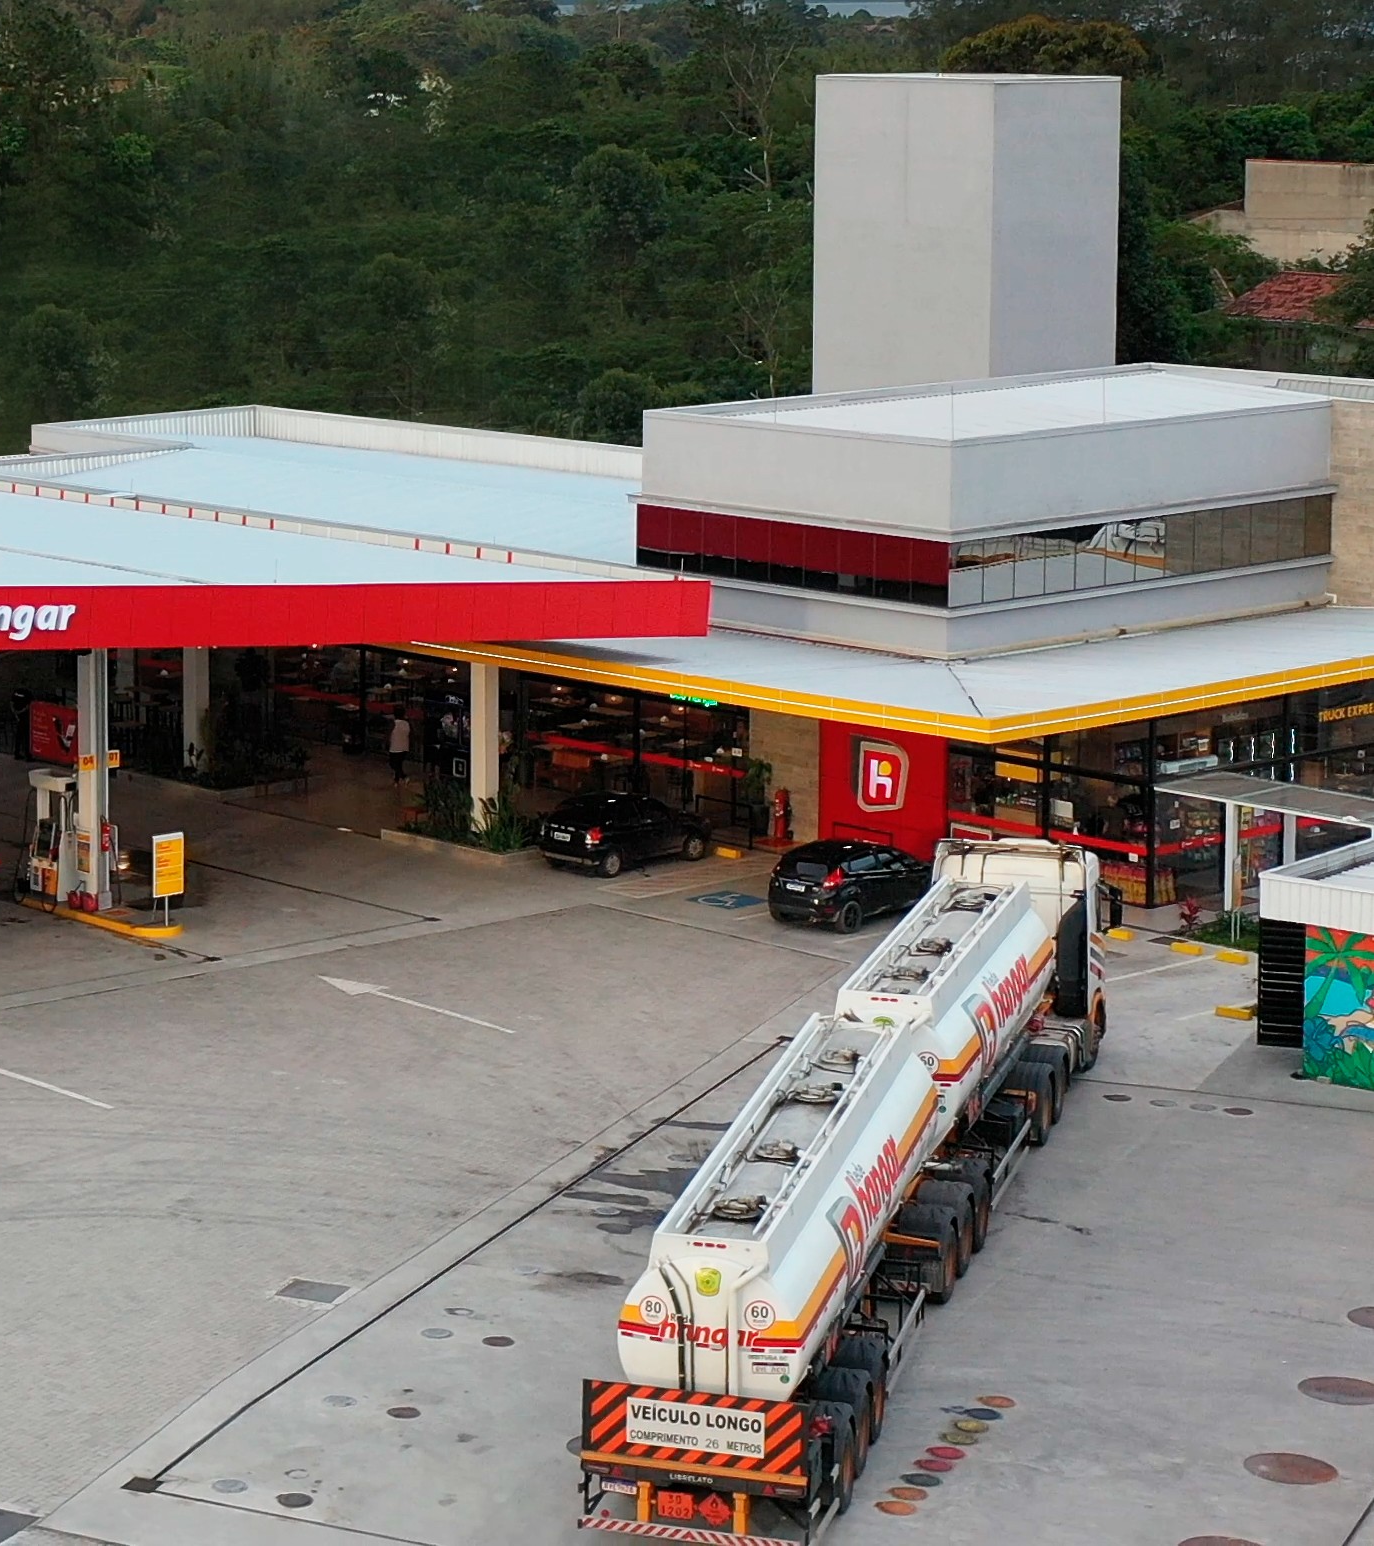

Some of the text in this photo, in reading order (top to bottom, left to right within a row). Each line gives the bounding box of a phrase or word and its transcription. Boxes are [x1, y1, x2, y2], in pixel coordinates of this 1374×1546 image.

[1319, 707, 1345, 722] TRUCK
[645, 1300, 662, 1314] 80
[750, 1305, 769, 1319] 60
[631, 1403, 762, 1433] VEÍCULO LONGO
[630, 1429, 762, 1454] COMPRIMENTO 26 METROS
[668, 1494, 682, 1504] 30
[662, 1505, 690, 1517] 1202
